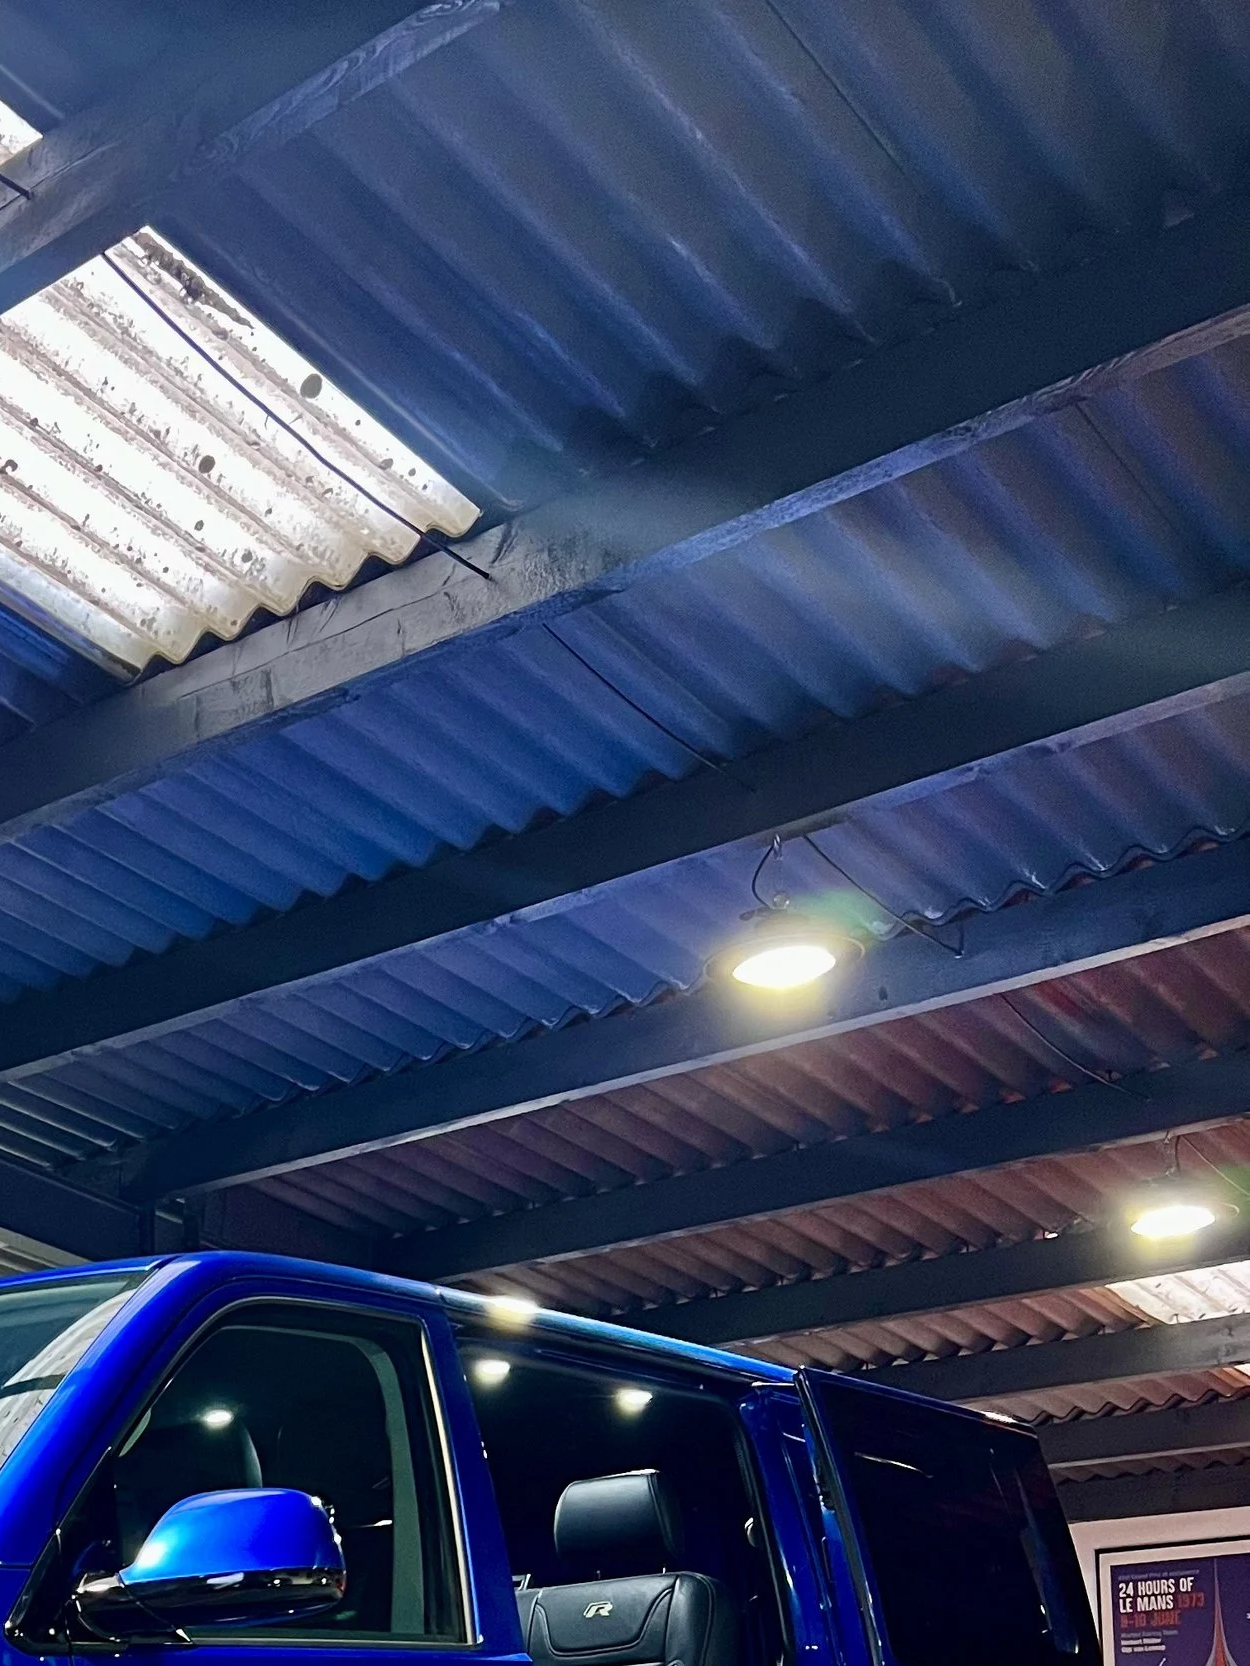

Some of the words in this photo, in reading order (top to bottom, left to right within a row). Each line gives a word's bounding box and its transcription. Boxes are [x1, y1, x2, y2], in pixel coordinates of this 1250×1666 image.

[1118, 1581, 1134, 1598] 24
[1137, 1578, 1175, 1596] HOURS
[1179, 1576, 1195, 1592] OF
[583, 1601, 613, 1618] R
[1119, 1598, 1133, 1613] LE
[1136, 1594, 1174, 1612] MANS
[1177, 1592, 1205, 1608] 1973
